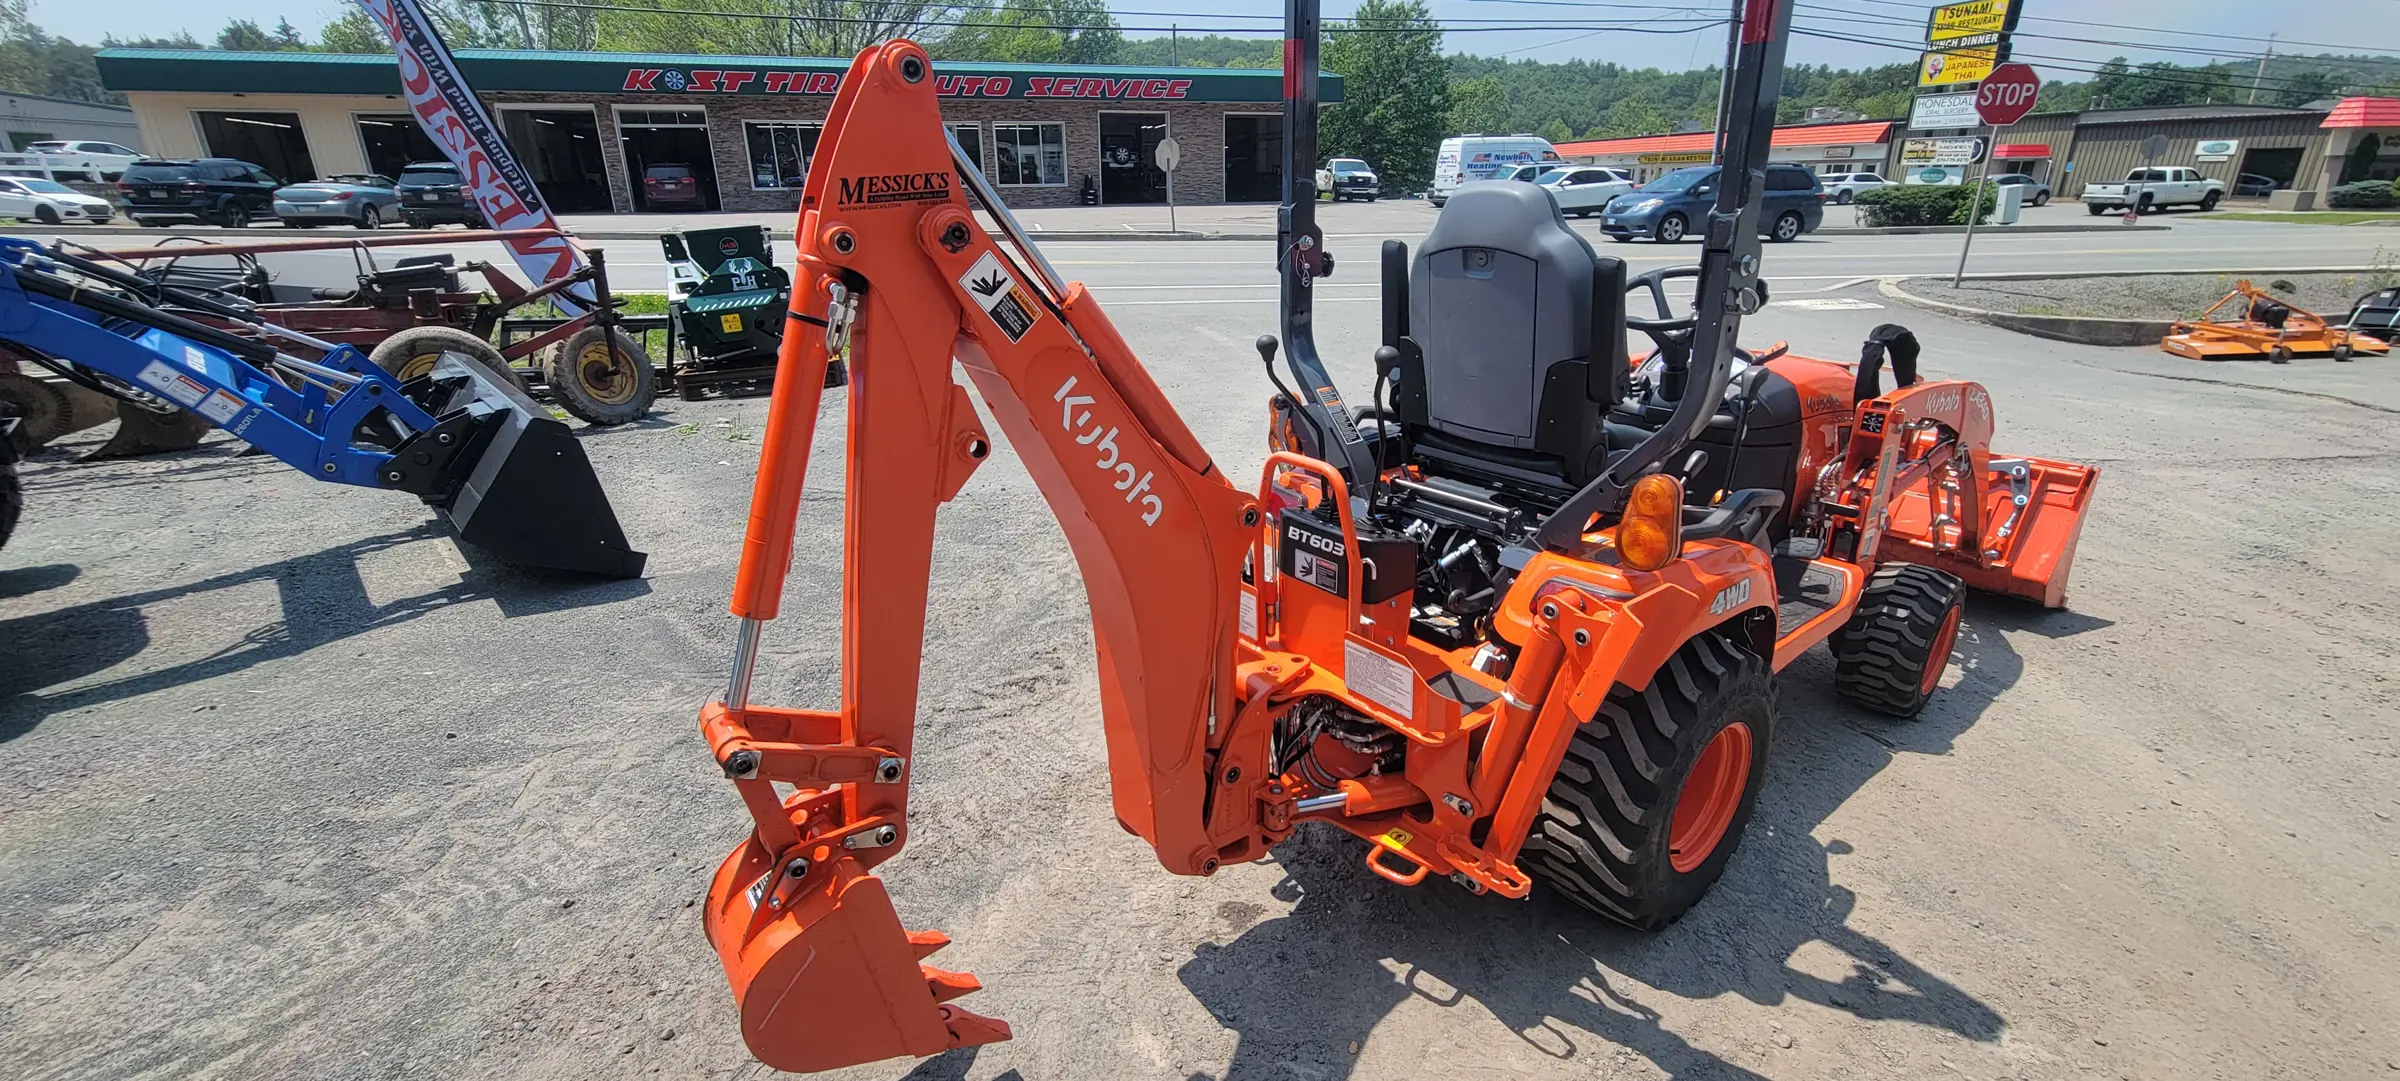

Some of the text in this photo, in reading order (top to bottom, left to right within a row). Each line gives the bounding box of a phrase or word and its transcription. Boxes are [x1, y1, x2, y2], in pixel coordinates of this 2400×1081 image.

[1942, 2, 1994, 20] TSUNAMI
[1958, 14, 2002, 28] RESTAURANT
[1927, 33, 1999, 51] LUNCH DINNER
[418, 42, 450, 85] With
[1946, 60, 1992, 71] JAPANESE
[1948, 49, 1992, 61] CHINESE
[935, 75, 1012, 96] UTO
[1023, 76, 1192, 99] SERVICE
[1954, 71, 1976, 80] THAI
[1917, 96, 1974, 109] HONESDAL
[1979, 82, 2036, 106] STOP
[449, 86, 485, 131] Hand
[482, 132, 527, 196] Helping
[838, 172, 949, 205] MESSICK'S
[1016, 292, 1038, 318] WARNING
[1805, 392, 1840, 413] Kubota
[1926, 389, 1960, 415] Kubota
[1053, 375, 1163, 527] Kubota
[1288, 525, 1345, 557] BT603
[1709, 577, 1751, 616] 4WD
